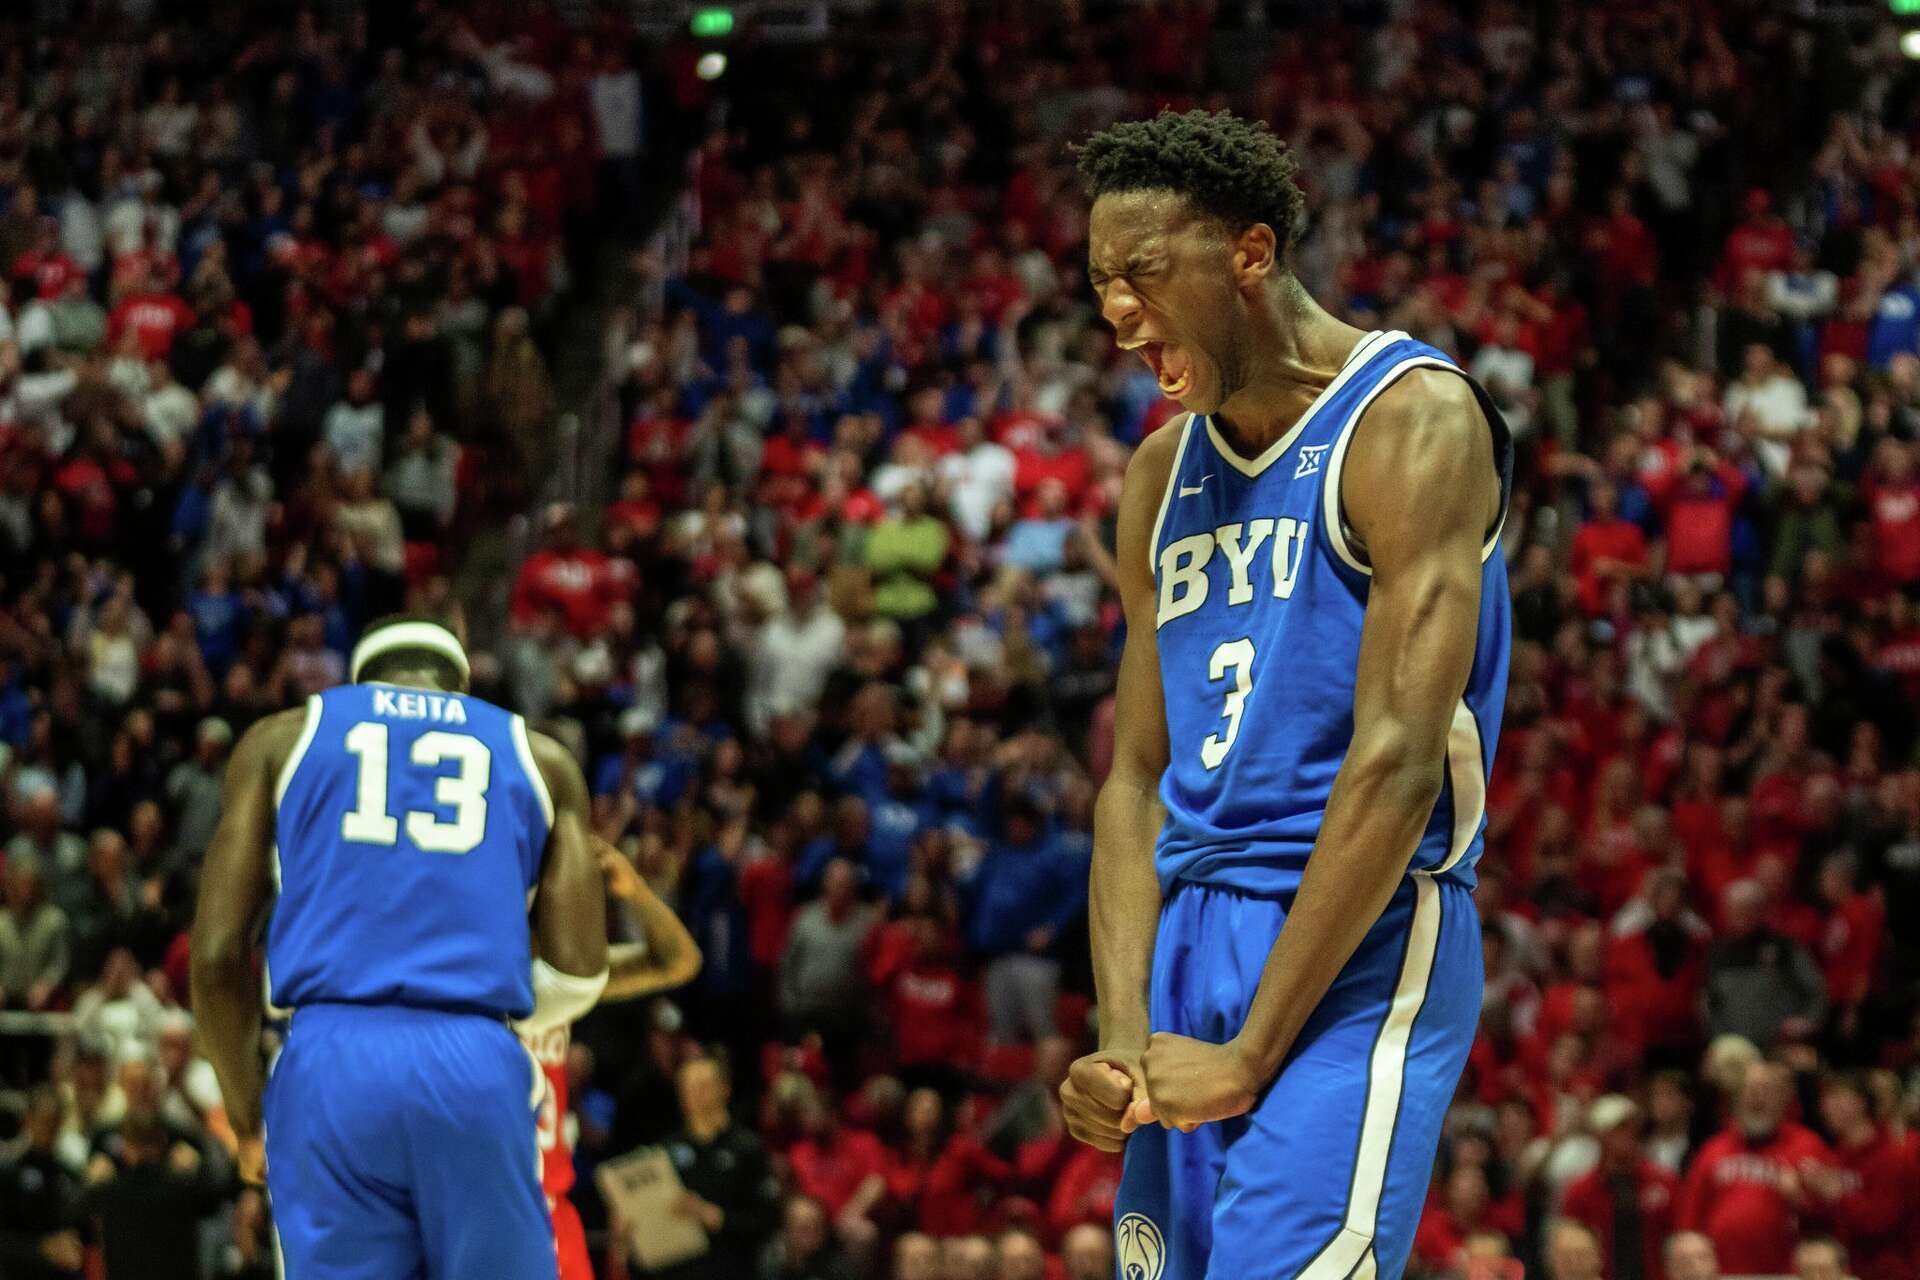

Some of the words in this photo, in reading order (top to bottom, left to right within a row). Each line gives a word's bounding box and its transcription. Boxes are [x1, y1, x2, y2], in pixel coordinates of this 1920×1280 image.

[1156, 518, 1309, 632] BYU
[373, 689, 467, 725] KEITA
[1200, 637, 1257, 771] 3
[342, 721, 491, 855] 13
